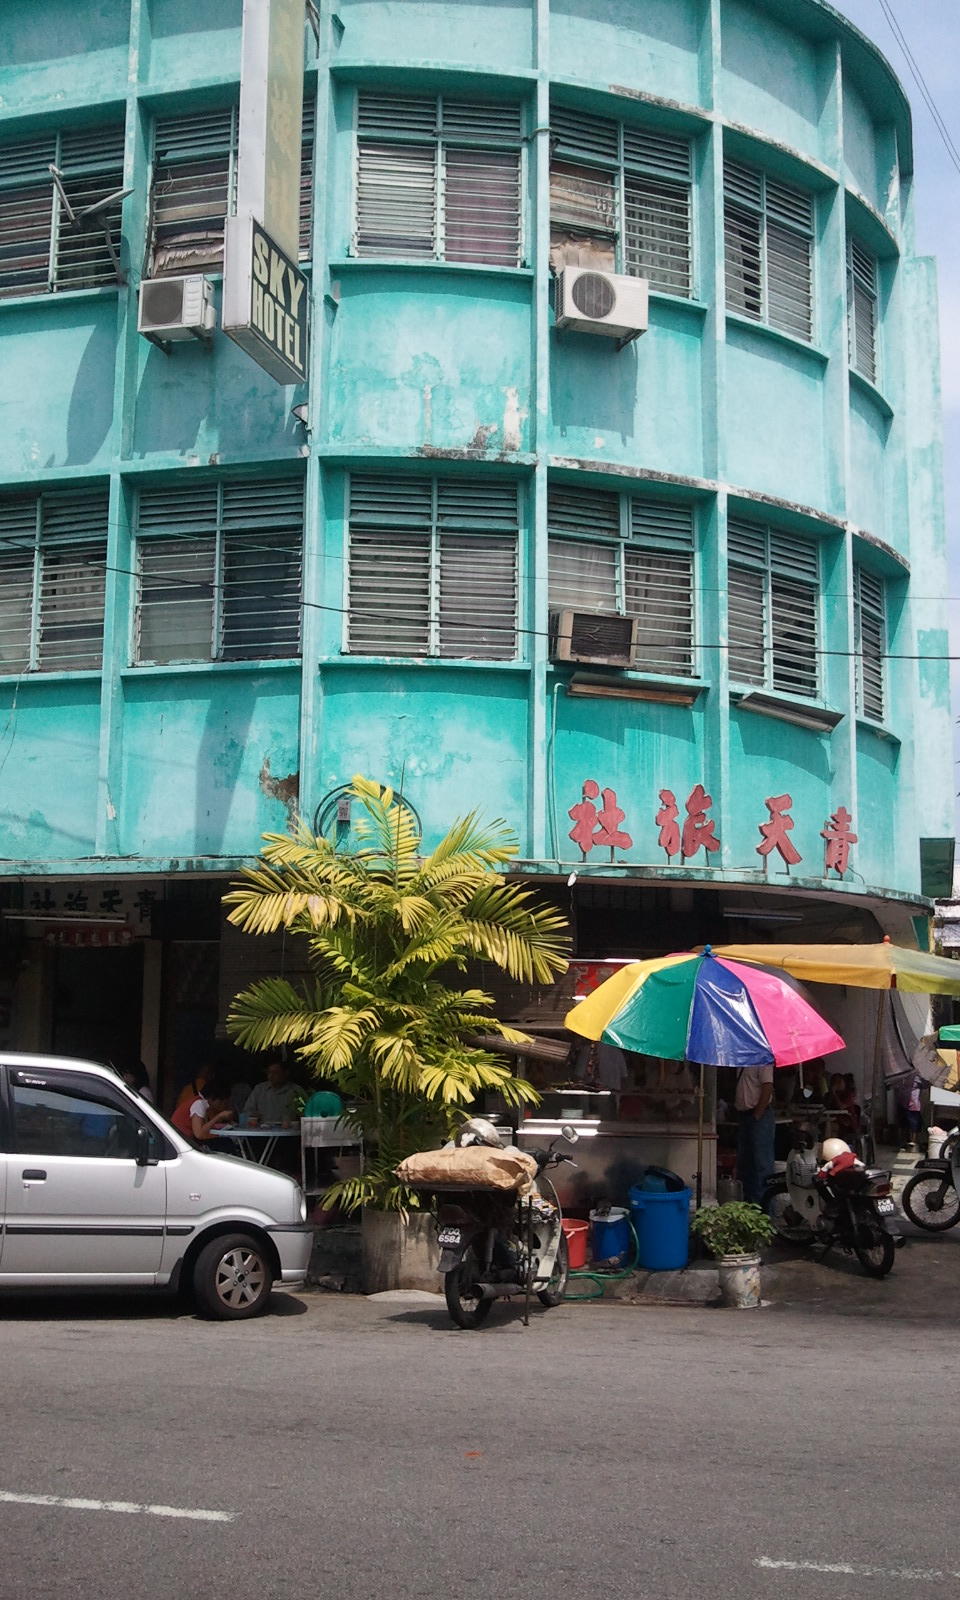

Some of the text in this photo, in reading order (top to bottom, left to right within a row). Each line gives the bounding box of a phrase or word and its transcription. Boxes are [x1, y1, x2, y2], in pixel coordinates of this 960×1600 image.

[253, 232, 305, 320] SKY
[252, 279, 303, 371] HOTEL
[878, 1203, 894, 1212] 1907
[438, 1234, 461, 1244] 6584
